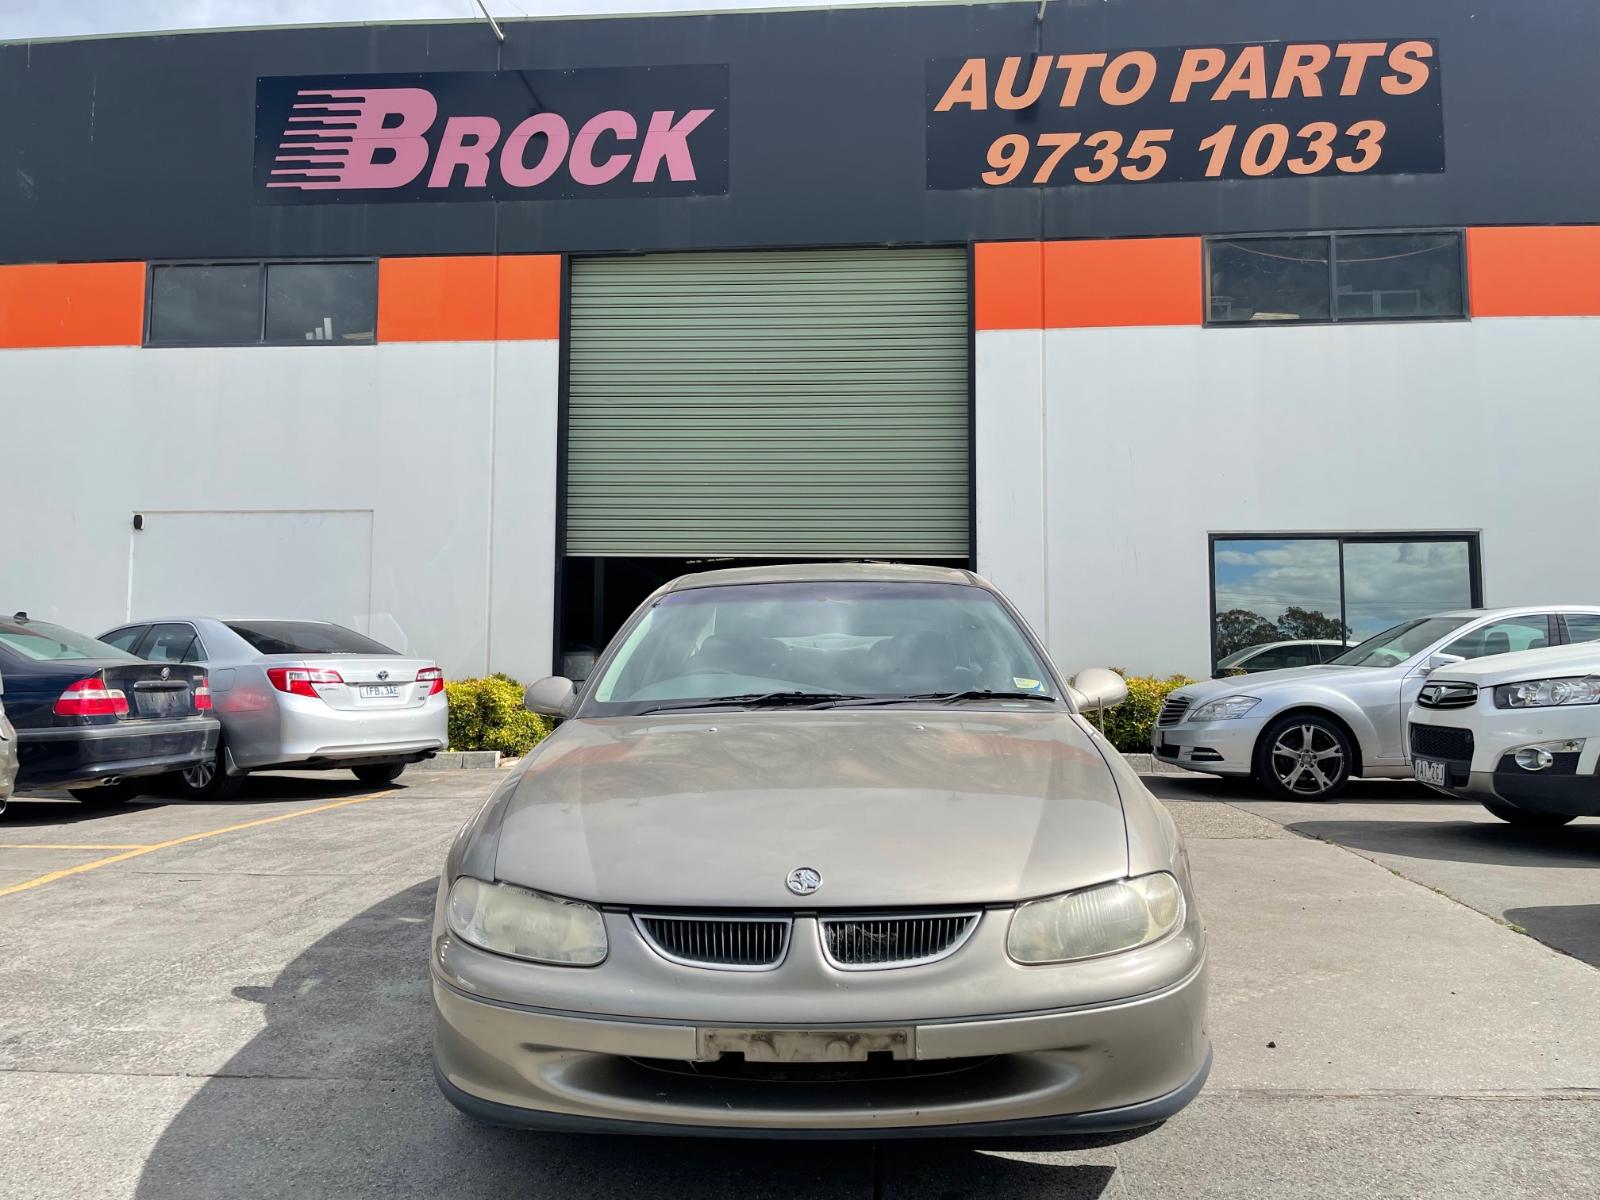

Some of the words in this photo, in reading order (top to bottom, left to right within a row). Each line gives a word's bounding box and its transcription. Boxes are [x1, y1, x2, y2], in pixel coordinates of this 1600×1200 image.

[934, 50, 1157, 112] AUTO
[1170, 40, 1433, 103] PARTS
[266, 87, 714, 190] BROCK
[981, 128, 1174, 186] 9735
[1199, 119, 1387, 178] 1033
